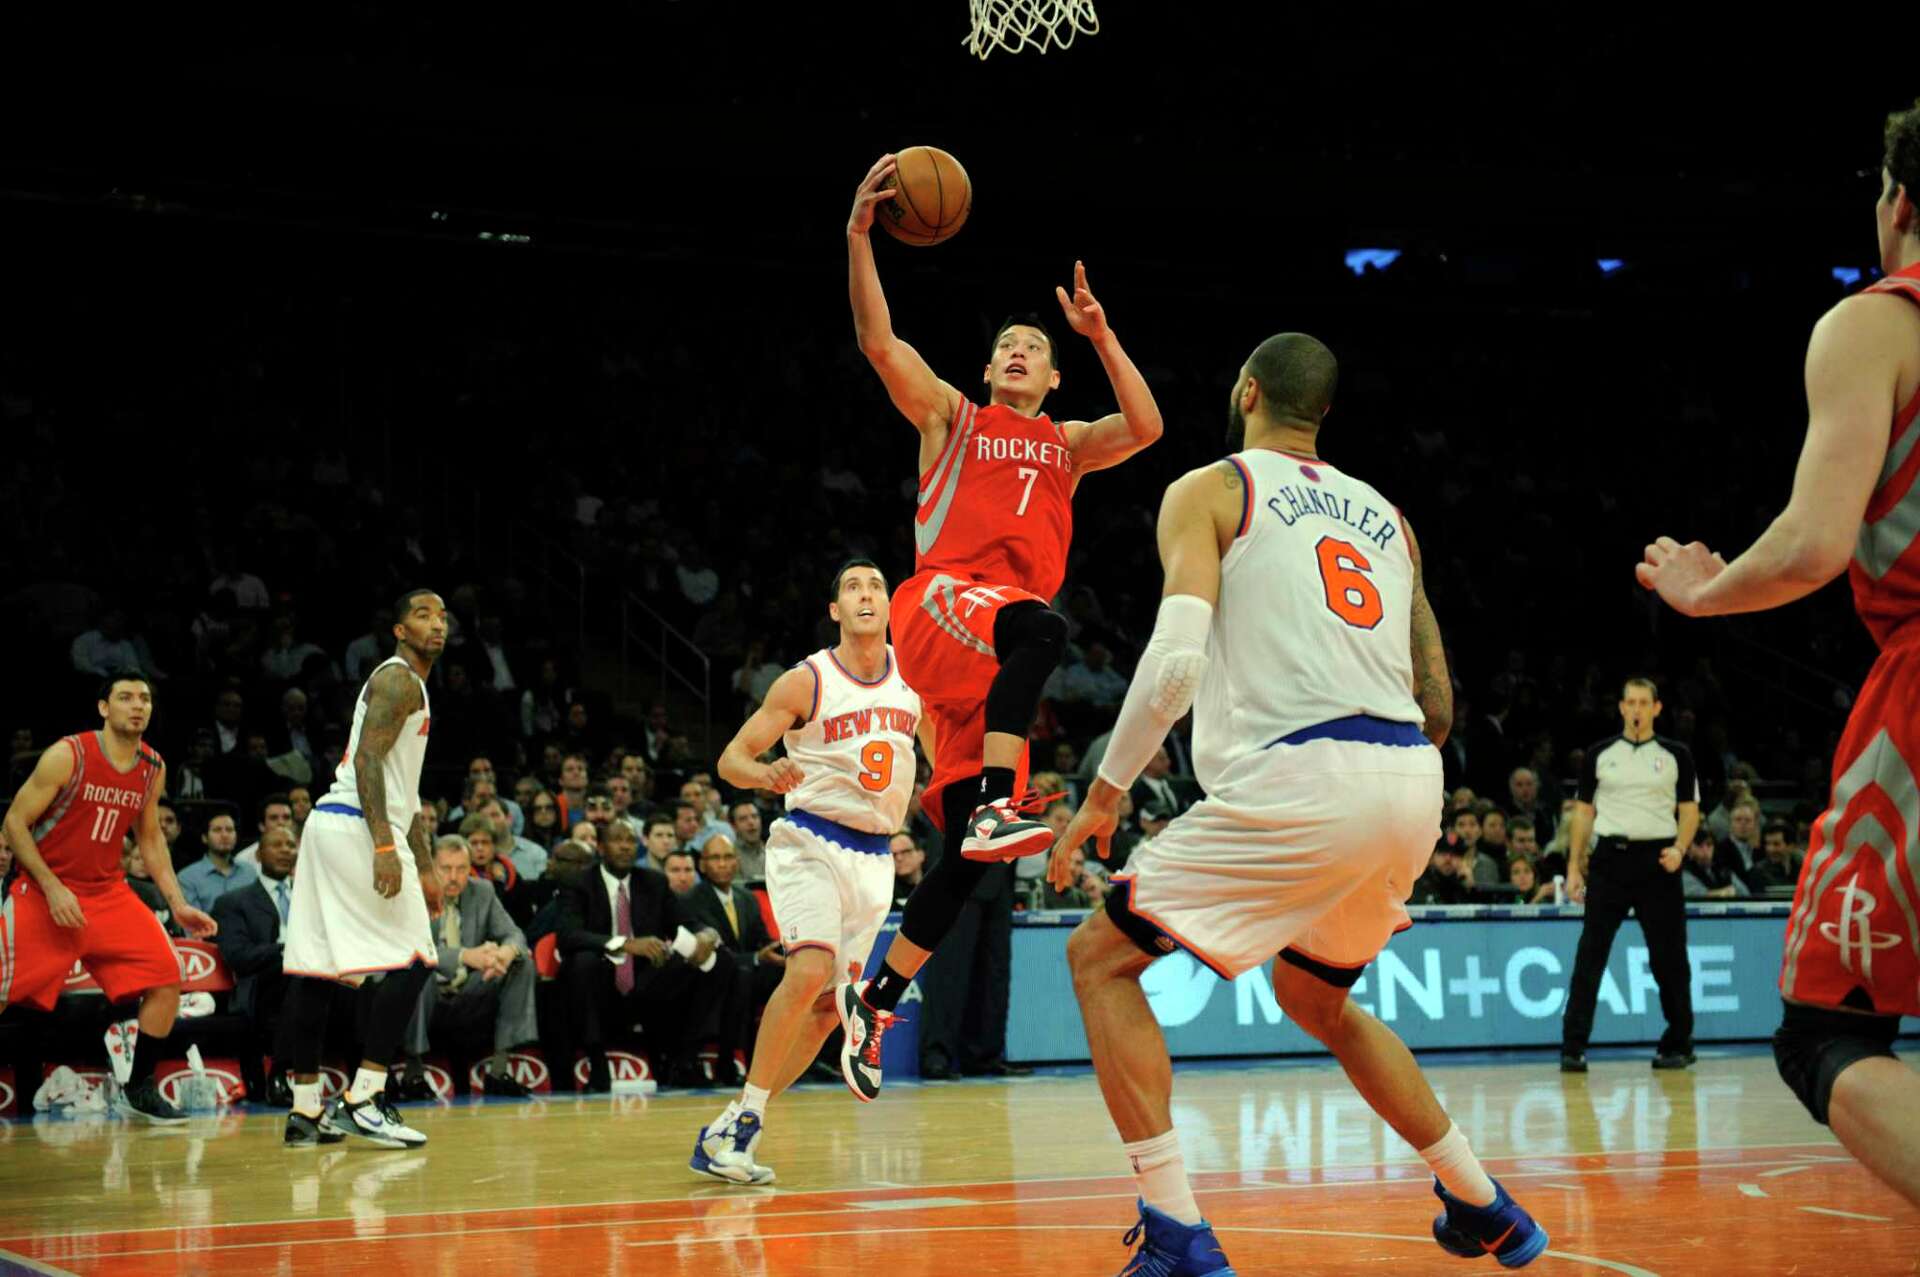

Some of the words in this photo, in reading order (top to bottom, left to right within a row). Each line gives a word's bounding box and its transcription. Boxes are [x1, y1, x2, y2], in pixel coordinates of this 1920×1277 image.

[974, 432, 1072, 473] ROCKETS
[1015, 467, 1039, 516] 7
[1267, 485, 1397, 551] CHANDLER
[1315, 535, 1385, 631] 6
[822, 708, 873, 745] NEW
[858, 740, 894, 792] 9
[82, 782, 143, 810] ROCKETS
[90, 806, 120, 843] 10
[1235, 945, 1740, 1025] MN+CARE
